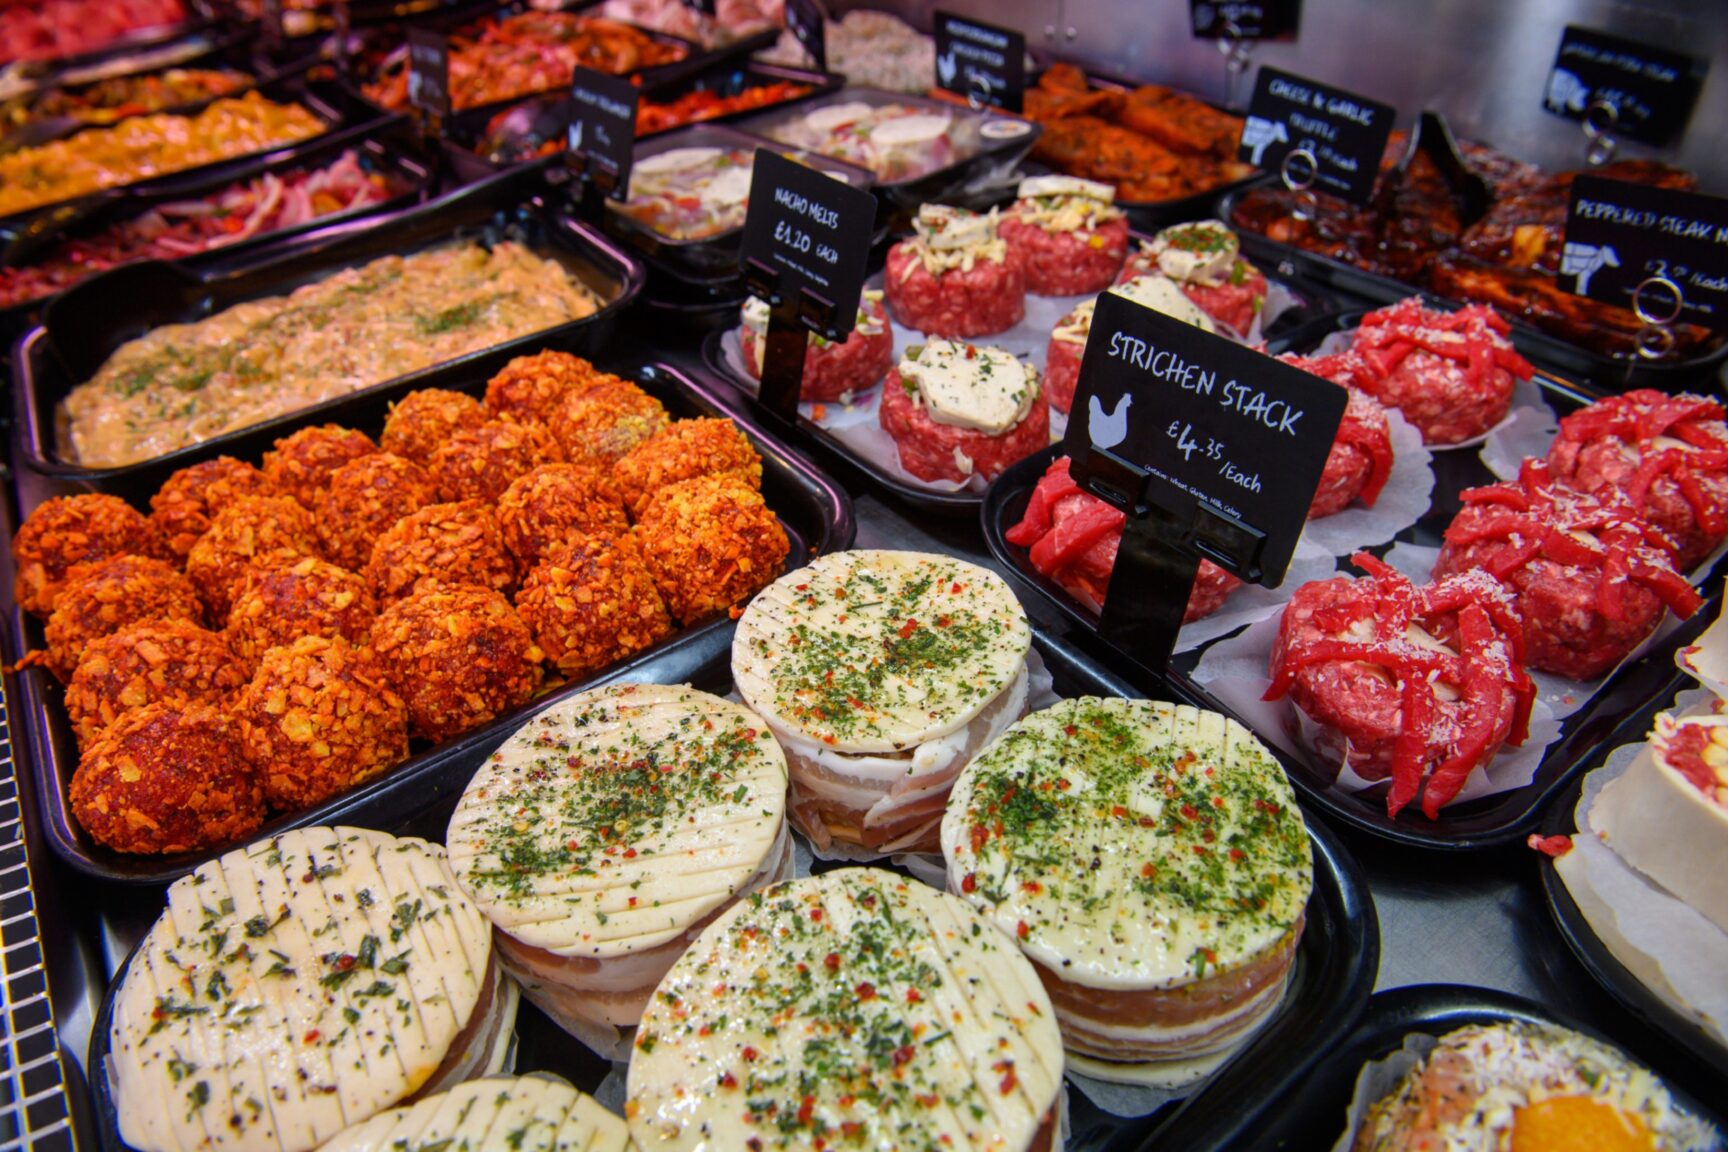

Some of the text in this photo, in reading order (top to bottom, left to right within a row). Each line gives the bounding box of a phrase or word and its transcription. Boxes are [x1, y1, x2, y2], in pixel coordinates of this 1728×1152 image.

[774, 187, 839, 229] NACHO MELTS
[1575, 199, 1657, 227] PEPPERED
[1659, 215, 1713, 240] STEAK
[1107, 331, 1303, 436] STRICHEN STACK
